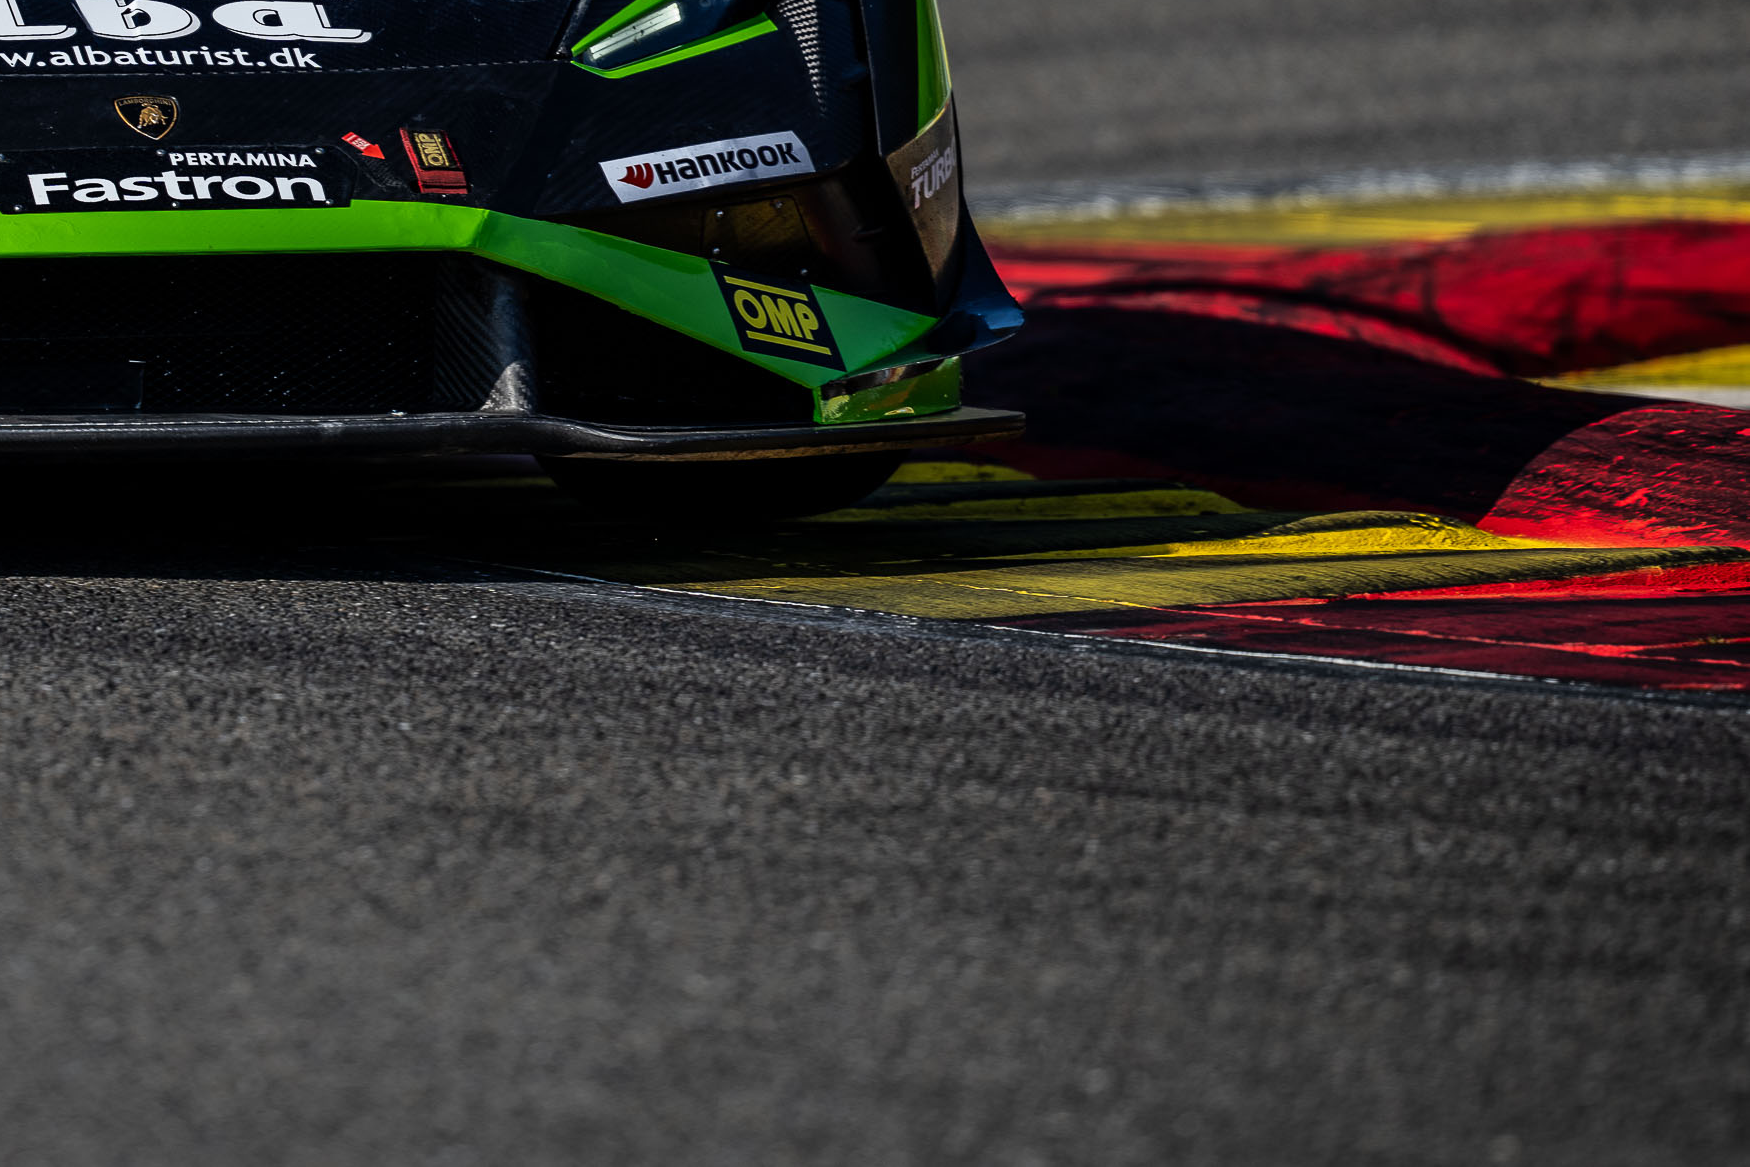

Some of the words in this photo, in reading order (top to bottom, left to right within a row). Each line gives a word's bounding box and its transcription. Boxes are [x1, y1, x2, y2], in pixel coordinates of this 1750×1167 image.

[168, 151, 318, 168] PERTAMINA
[27, 170, 327, 206] Fastron
[733, 289, 819, 341] OMP
